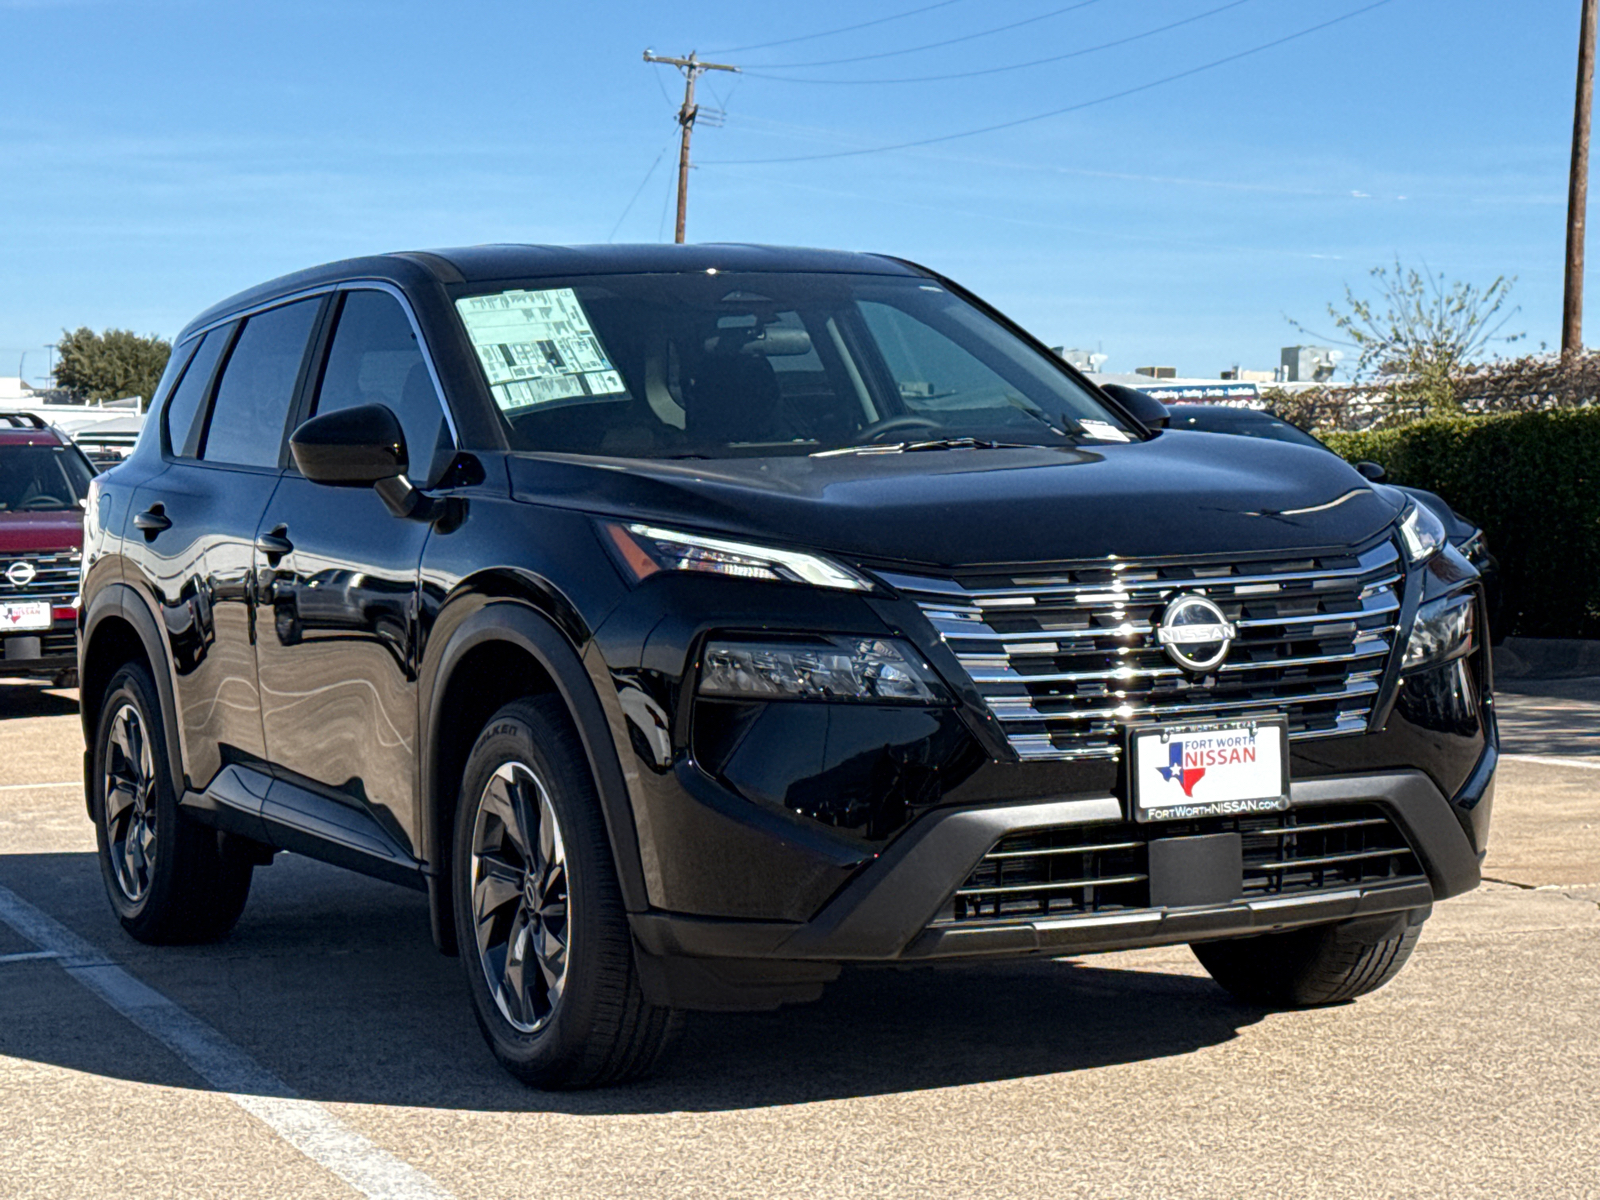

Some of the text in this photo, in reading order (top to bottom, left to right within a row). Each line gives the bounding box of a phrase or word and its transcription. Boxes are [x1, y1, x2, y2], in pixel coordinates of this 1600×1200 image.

[1158, 624, 1236, 643] NISSAN
[1231, 720, 1257, 729] TEXAS
[1185, 736, 1256, 750] FORT WORTH
[1185, 747, 1256, 767] NISSAN
